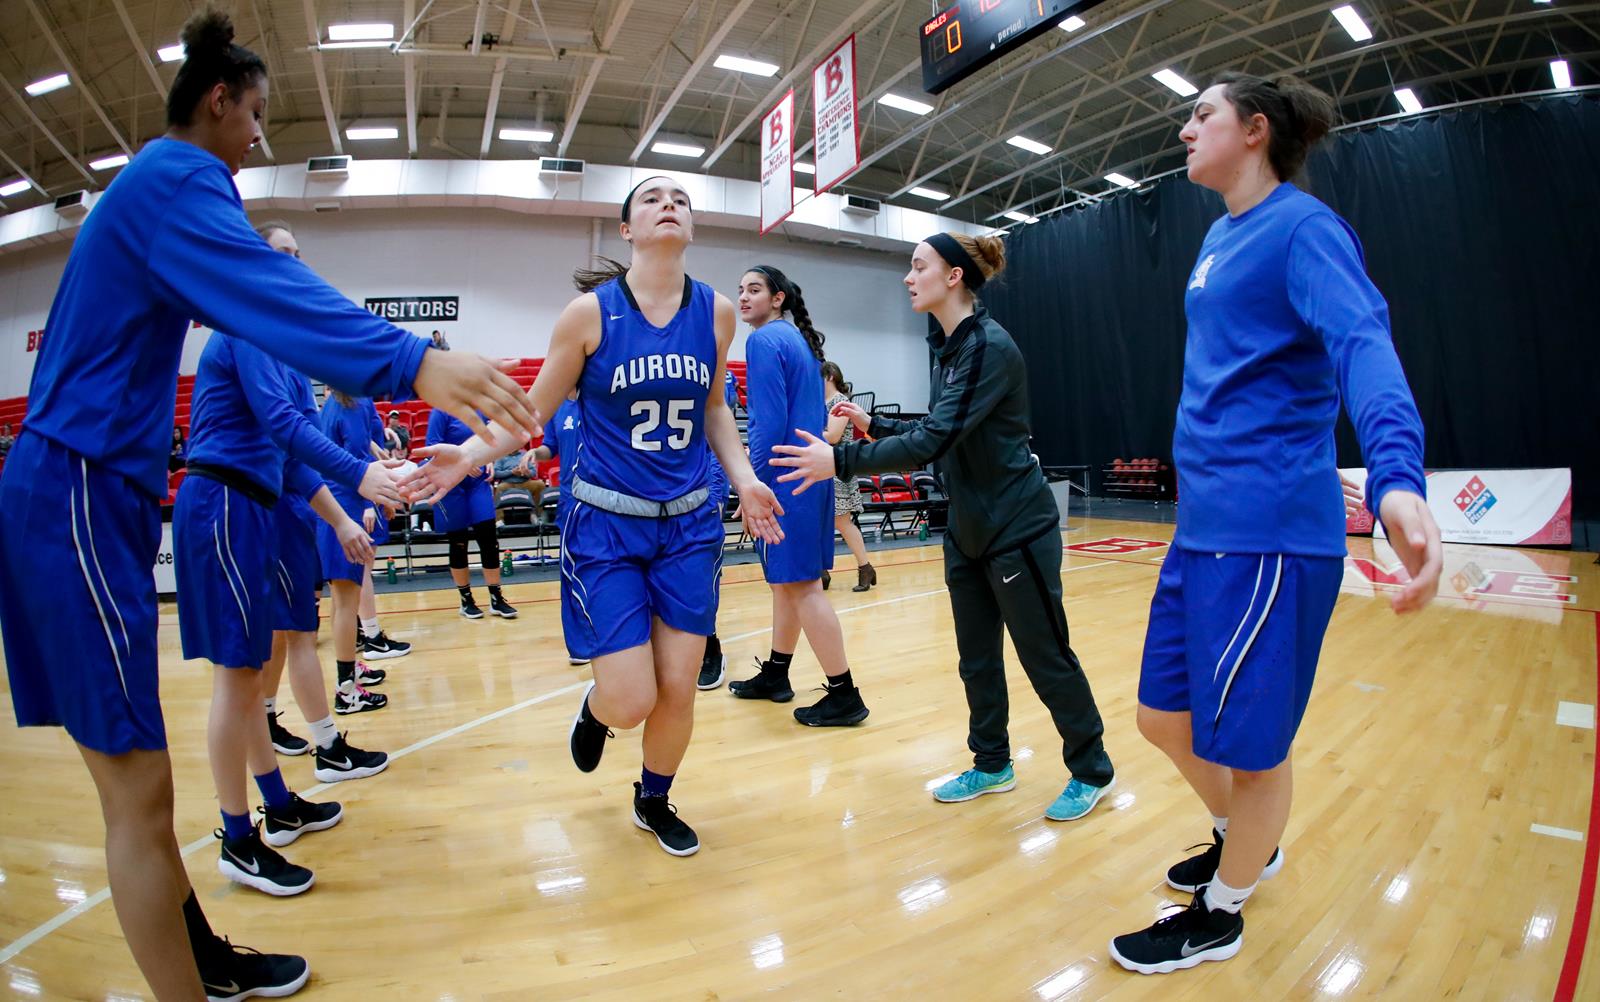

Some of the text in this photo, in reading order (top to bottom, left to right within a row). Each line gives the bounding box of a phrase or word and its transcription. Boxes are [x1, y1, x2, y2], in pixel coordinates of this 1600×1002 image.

[925, 12, 947, 35] EAGLES
[947, 20, 962, 53] 0
[997, 19, 1022, 43] period
[824, 55, 843, 99] B
[769, 108, 783, 149] B
[366, 301, 457, 318] VISITORS
[610, 353, 711, 394] AURORA
[630, 400, 695, 451] 25
